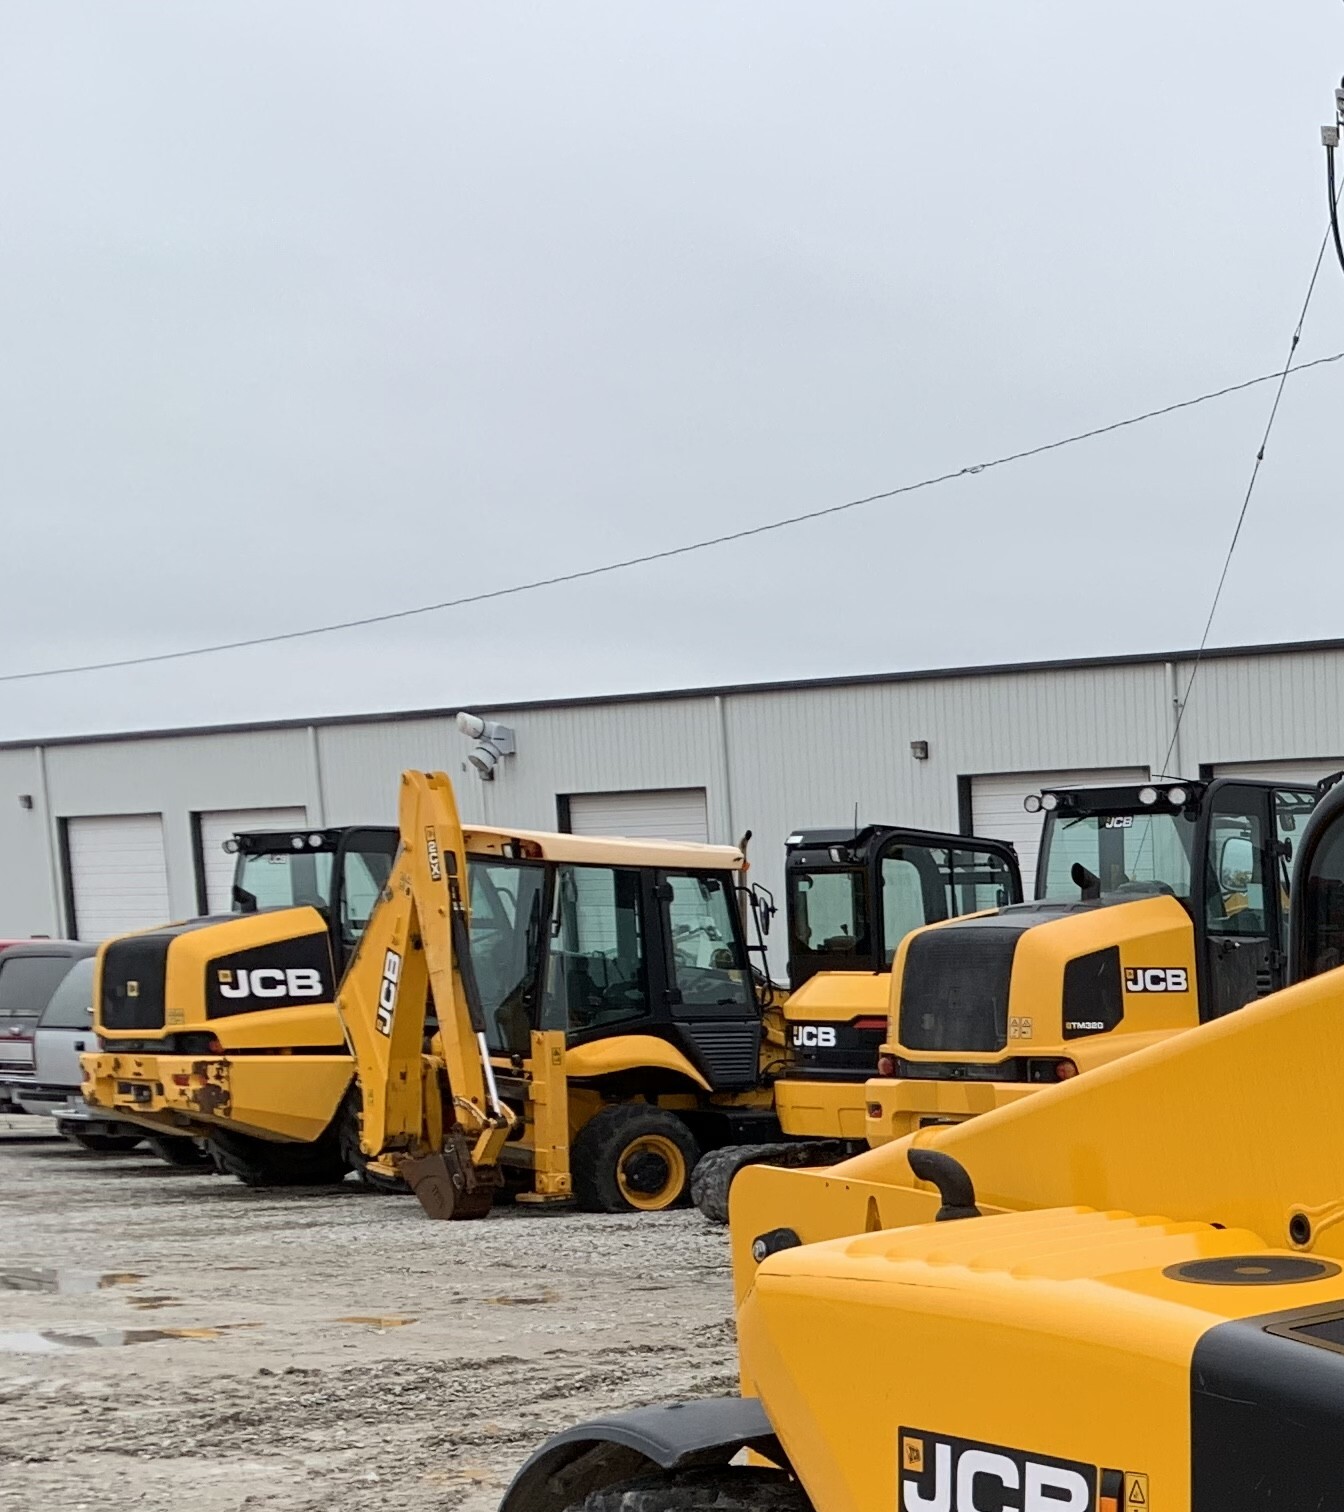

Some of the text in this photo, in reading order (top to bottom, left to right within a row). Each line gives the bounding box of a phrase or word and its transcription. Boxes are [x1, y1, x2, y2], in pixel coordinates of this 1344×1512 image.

[1105, 816, 1133, 828] JCB
[218, 968, 323, 998] JCB
[1127, 968, 1187, 991] JCB
[378, 949, 401, 1035] JCB
[793, 1025, 836, 1047] JCB
